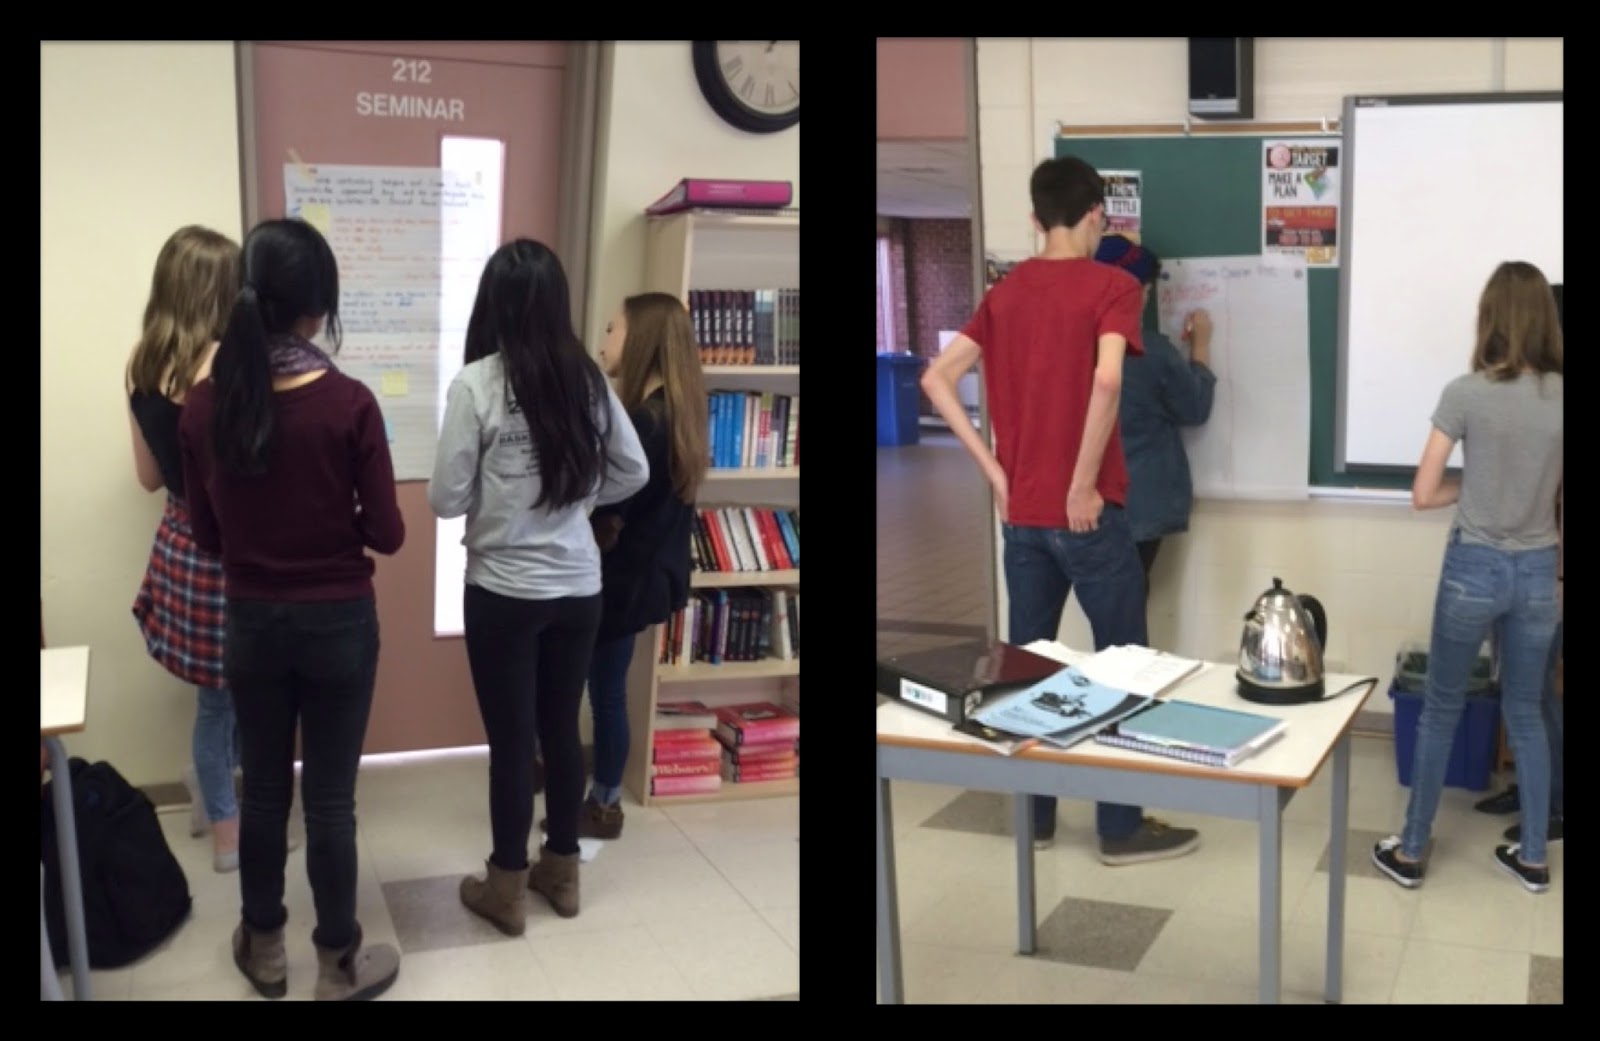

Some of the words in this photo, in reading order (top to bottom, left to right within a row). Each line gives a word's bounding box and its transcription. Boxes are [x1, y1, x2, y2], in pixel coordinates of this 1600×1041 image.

[392, 58, 432, 83] 212
[356, 92, 465, 121] SEMINAR
[1268, 172, 1293, 185] MAKE
[1273, 186, 1298, 198] PLAN
